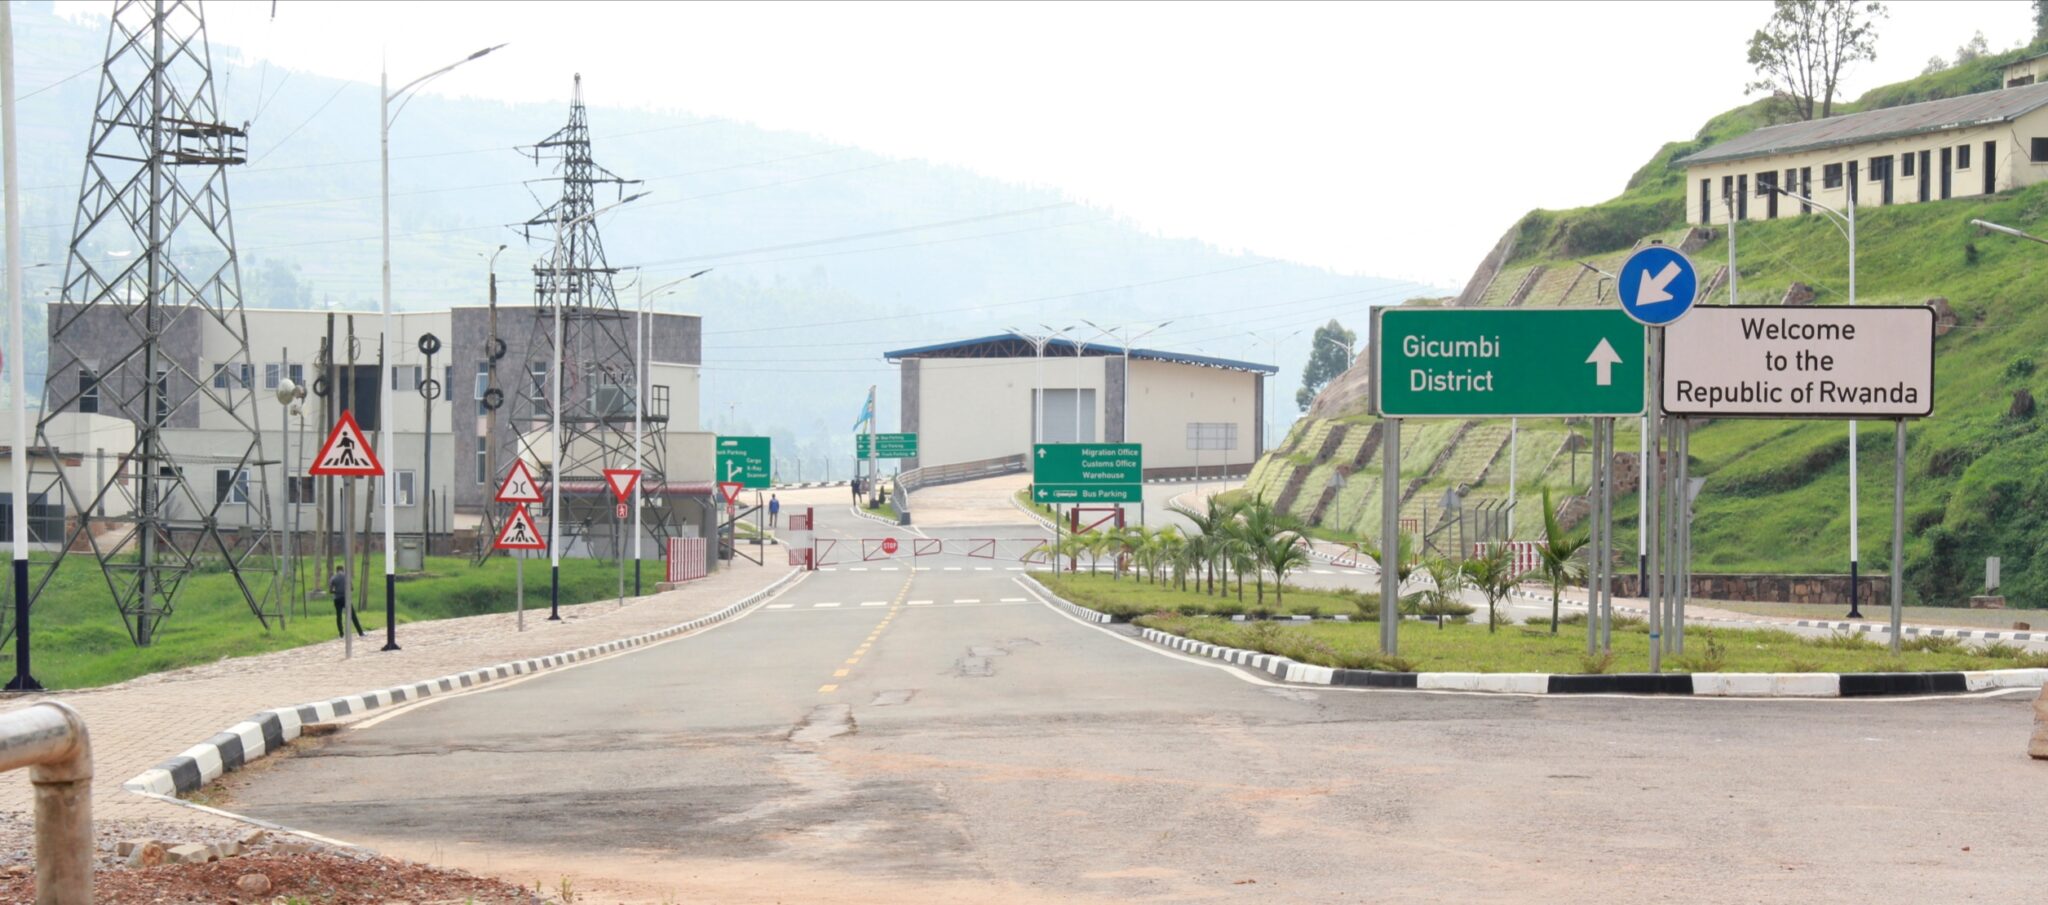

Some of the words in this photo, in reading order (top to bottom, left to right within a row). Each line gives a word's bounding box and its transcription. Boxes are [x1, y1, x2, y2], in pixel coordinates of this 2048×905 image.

[1741, 318, 1855, 340] Welcome
[1403, 335, 1500, 357] Gicumbi
[1765, 351, 1787, 371] to
[1796, 350, 1834, 371] the
[1410, 369, 1494, 391] District
[1677, 381, 1782, 408] Republic
[1790, 382, 1813, 403] of
[1820, 381, 1917, 404] Rwanda
[1082, 449, 1115, 457] Migration
[1082, 460, 1113, 468] Customs
[1115, 460, 1136, 468] Office
[1083, 490, 1096, 498] Bus
[1099, 490, 1127, 499] Parking
